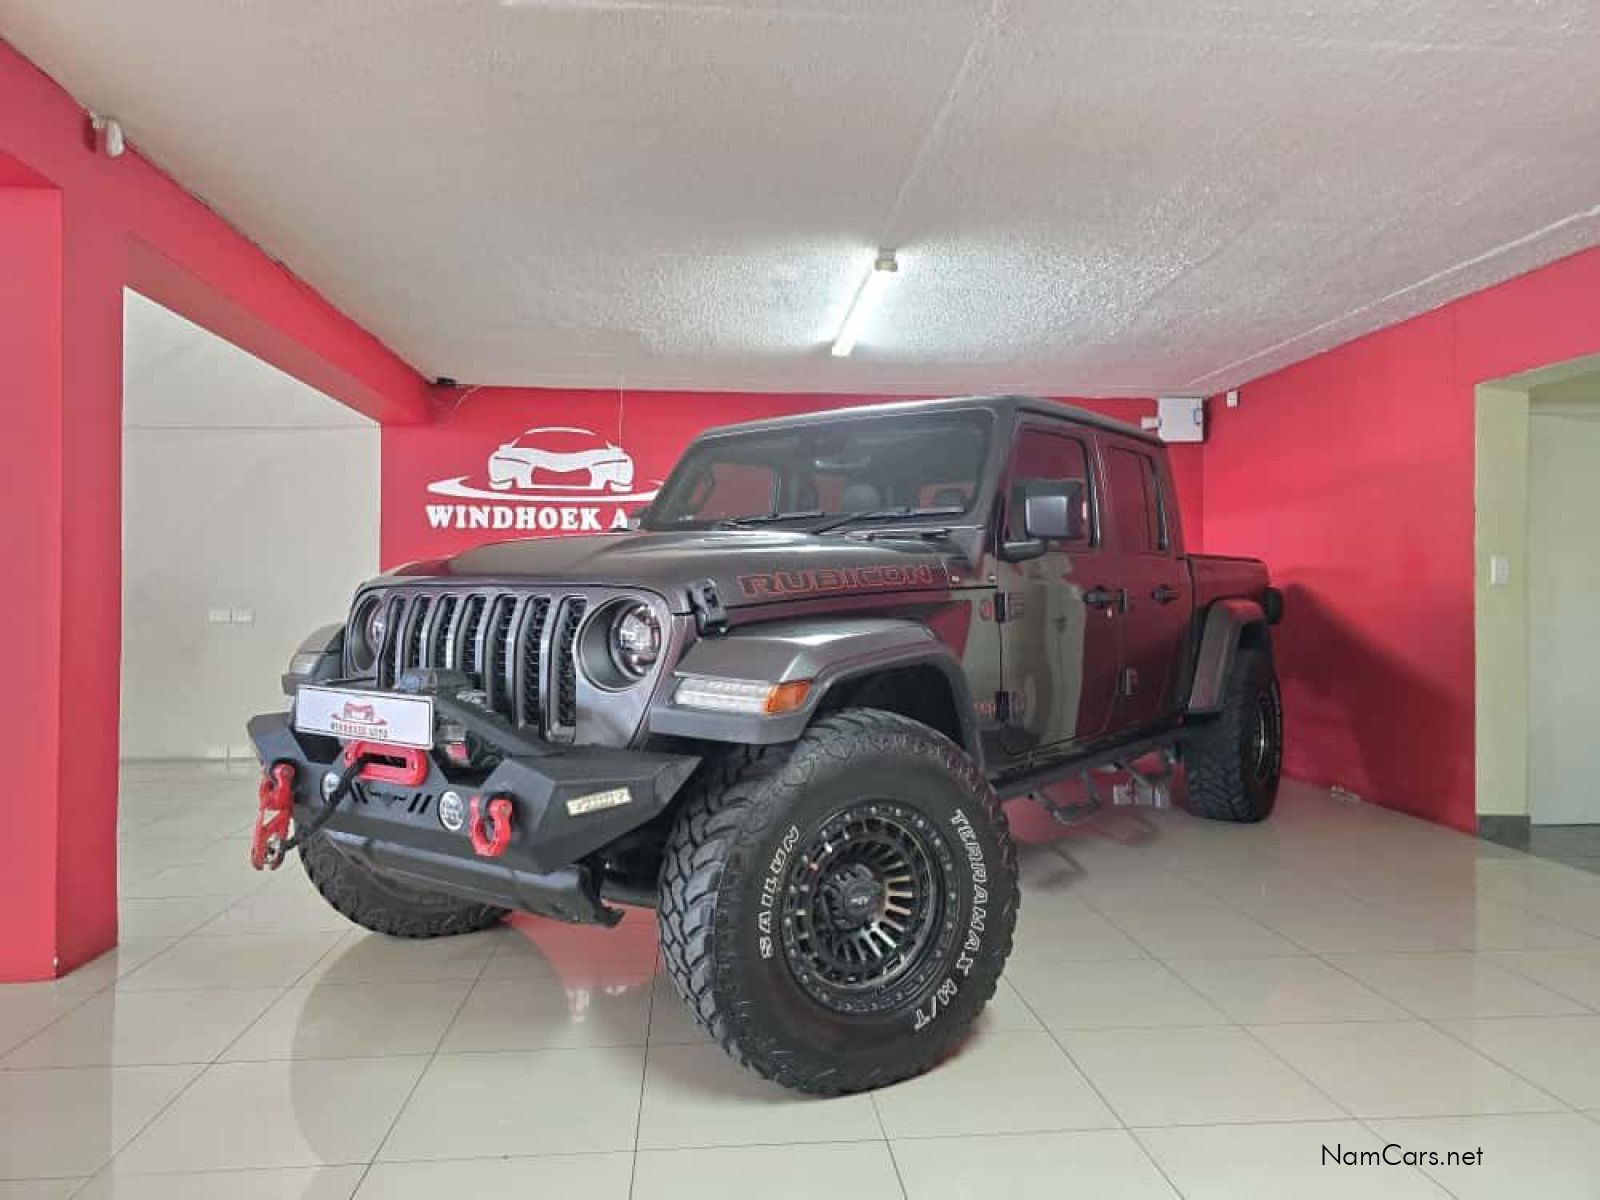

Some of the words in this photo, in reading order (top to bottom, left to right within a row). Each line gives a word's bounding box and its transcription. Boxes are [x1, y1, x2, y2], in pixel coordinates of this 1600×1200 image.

[425, 505, 600, 530] WINDHOEK
[736, 564, 934, 597] RUBICON
[758, 825, 799, 958] SAILUN
[952, 808, 989, 975] TERRAMAX
[913, 977, 958, 1031] M/T
